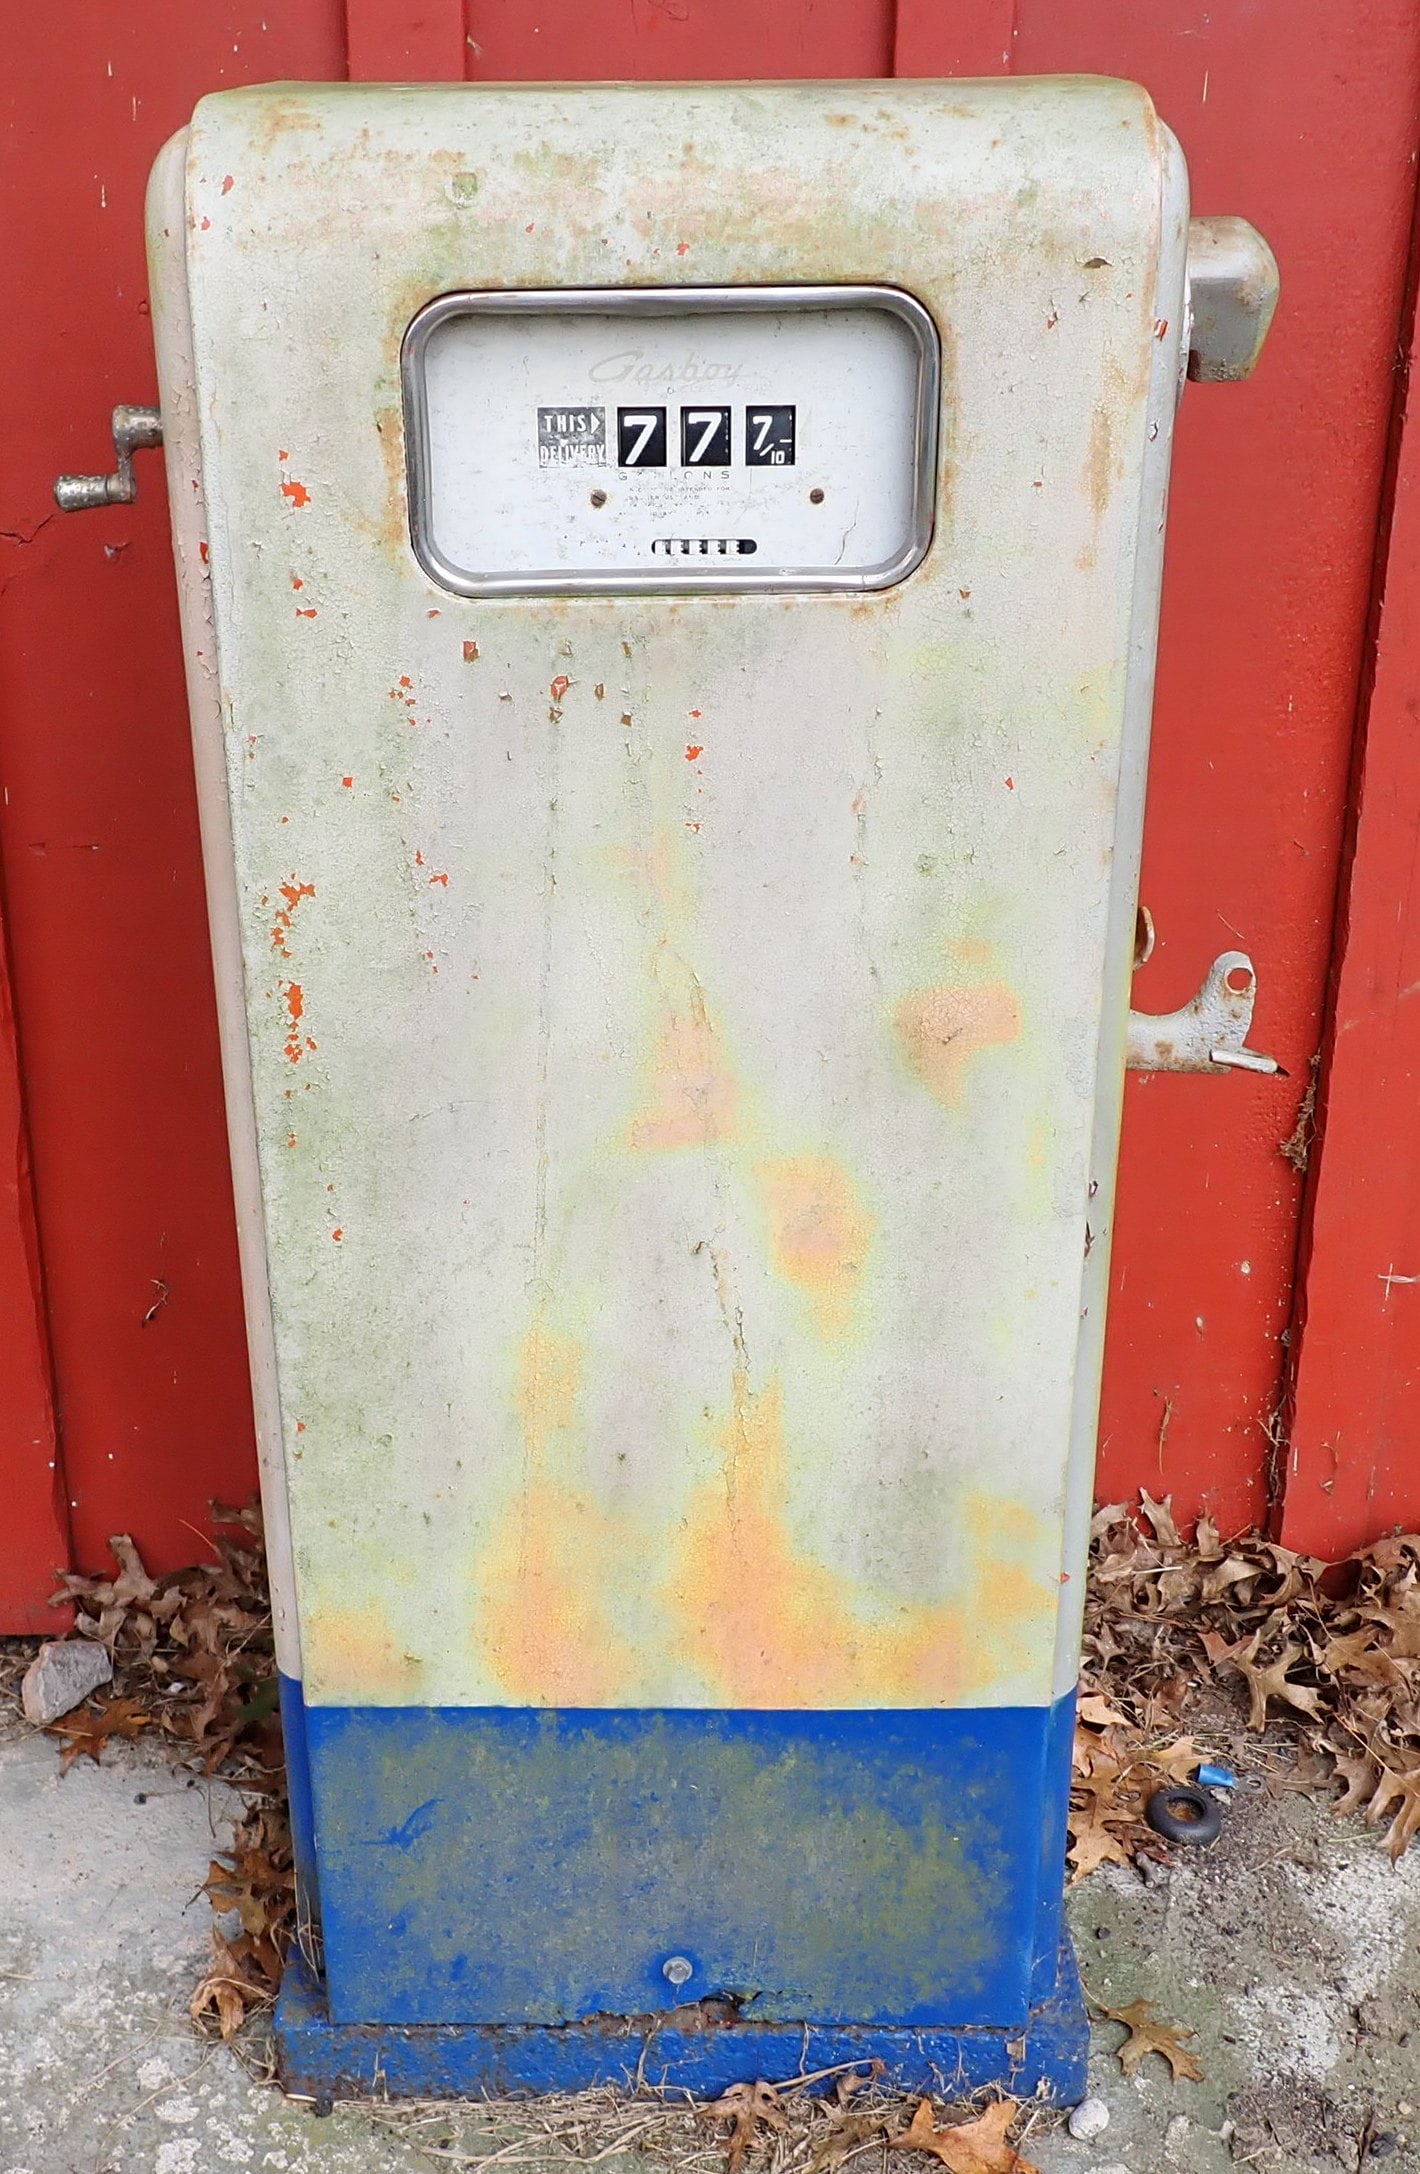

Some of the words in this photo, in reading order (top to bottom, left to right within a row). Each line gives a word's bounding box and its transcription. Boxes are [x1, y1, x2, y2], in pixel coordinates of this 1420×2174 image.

[588, 350, 743, 386] Gasboy
[544, 414, 587, 433] THIS
[623, 415, 658, 465] 7
[688, 412, 722, 463] 7
[540, 444, 606, 466] DELIVERY
[618, 470, 730, 481] GONS
